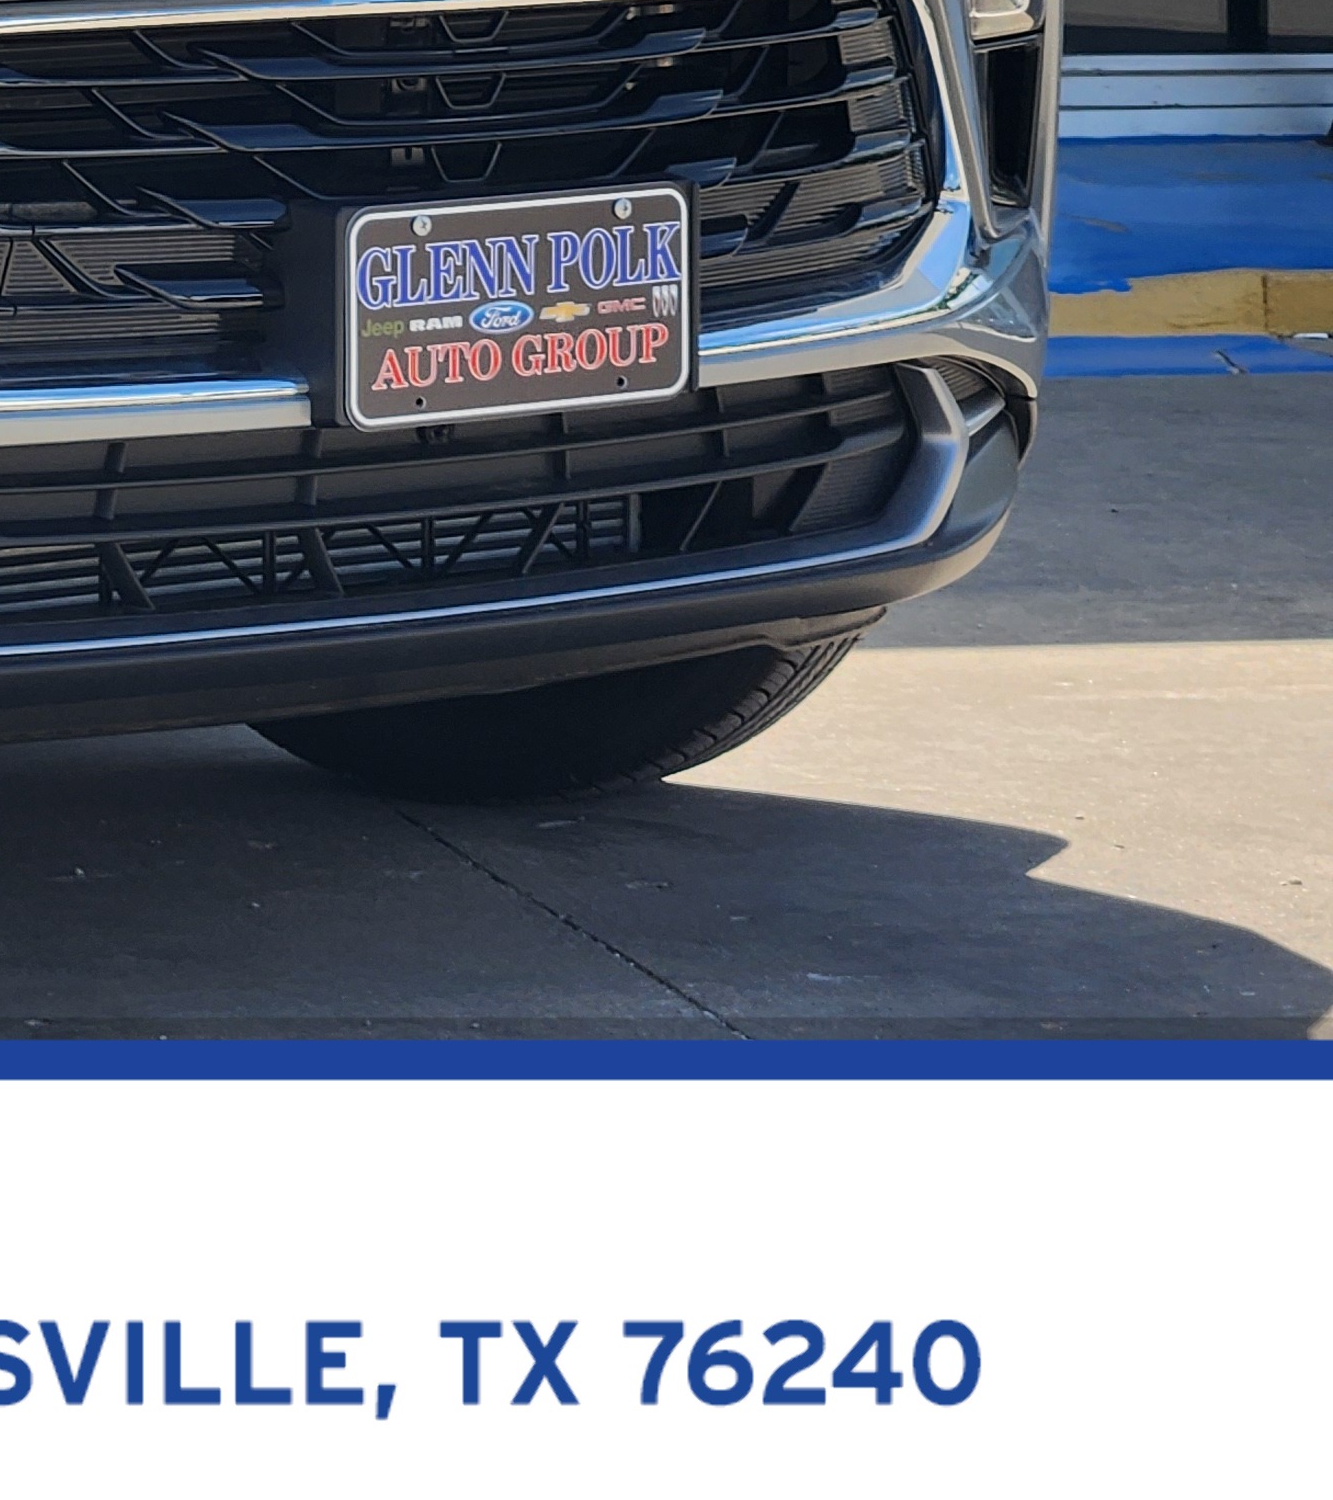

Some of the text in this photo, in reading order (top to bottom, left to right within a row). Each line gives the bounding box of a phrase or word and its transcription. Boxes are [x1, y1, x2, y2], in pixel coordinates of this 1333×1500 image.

[357, 221, 683, 310] GLENN POLK
[361, 297, 647, 338] Jeep RAM Ford GMC
[371, 322, 670, 391] AUTO GROUP
